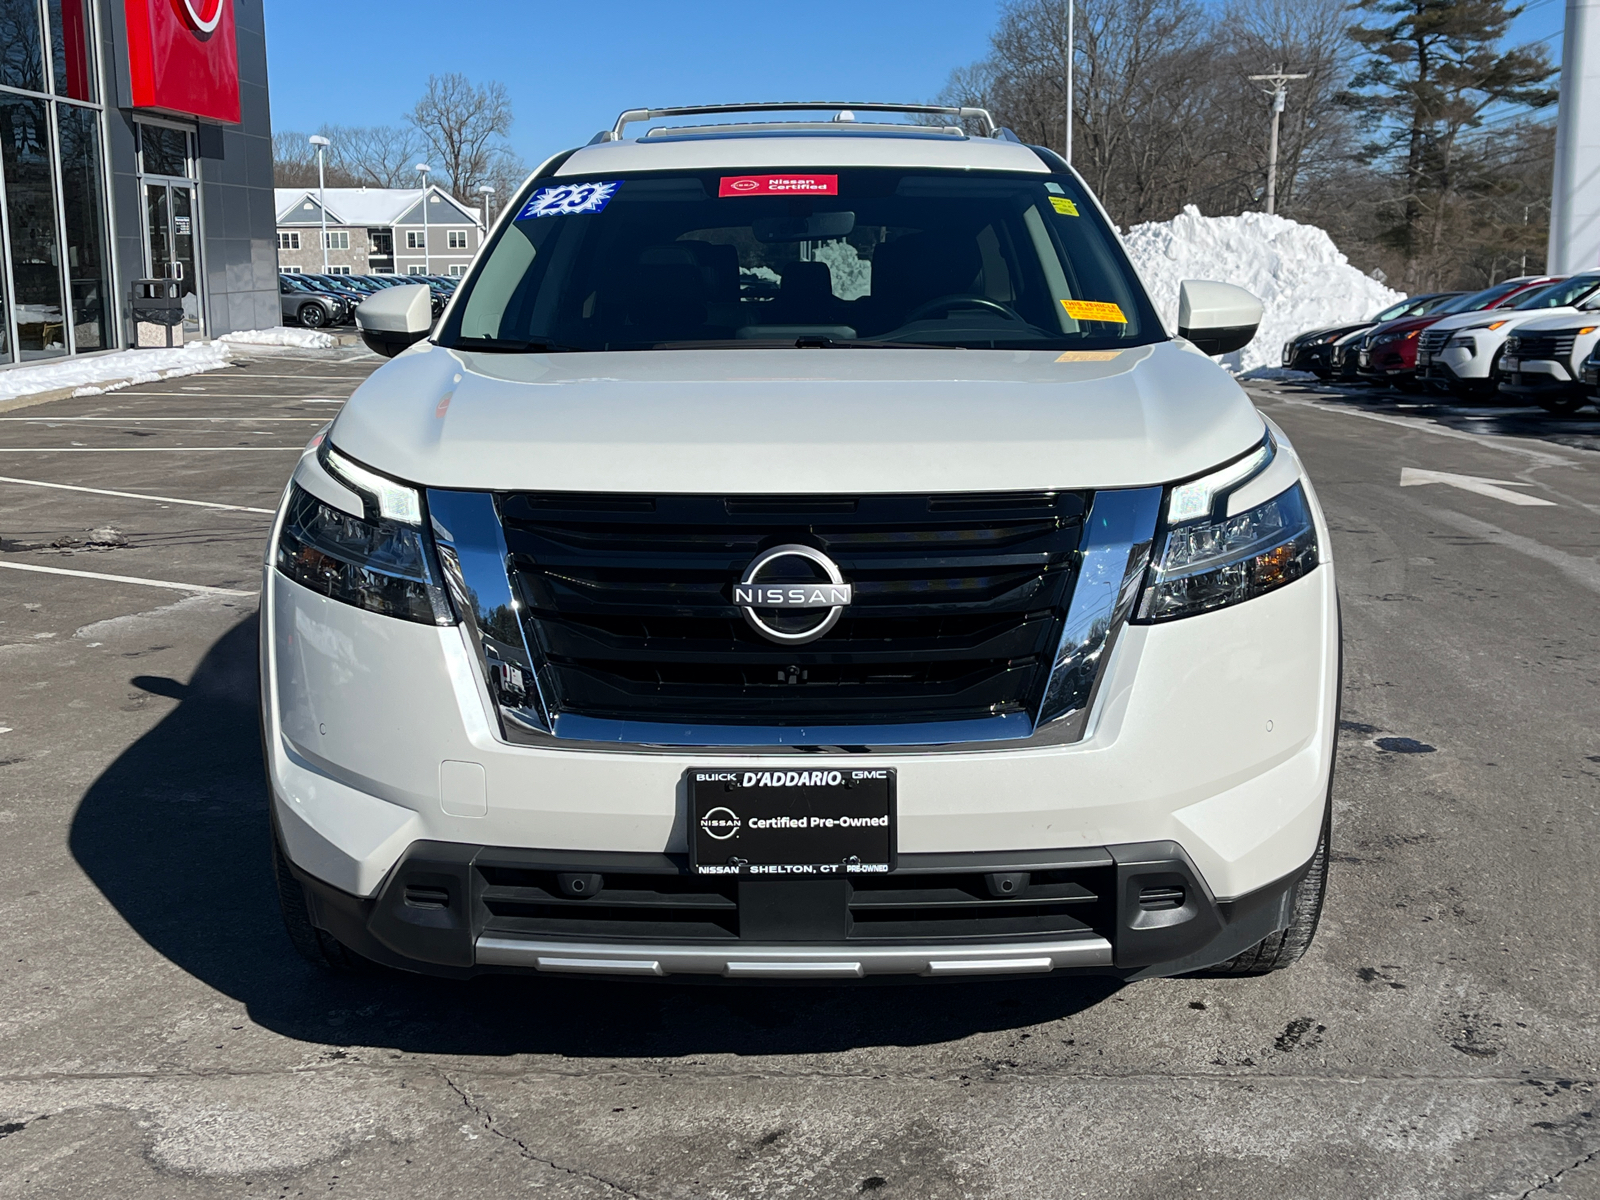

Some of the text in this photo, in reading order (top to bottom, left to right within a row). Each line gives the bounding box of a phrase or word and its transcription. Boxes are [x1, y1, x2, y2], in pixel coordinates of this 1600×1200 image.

[541, 187, 596, 210] 23
[735, 588, 848, 604] NISSAN
[696, 770, 887, 788] BUICK D'ADDARIO GMC
[748, 815, 889, 829] Certified Pre-Owned
[698, 864, 889, 874] NISSAN SHELTON, CT PRE-OWNED
